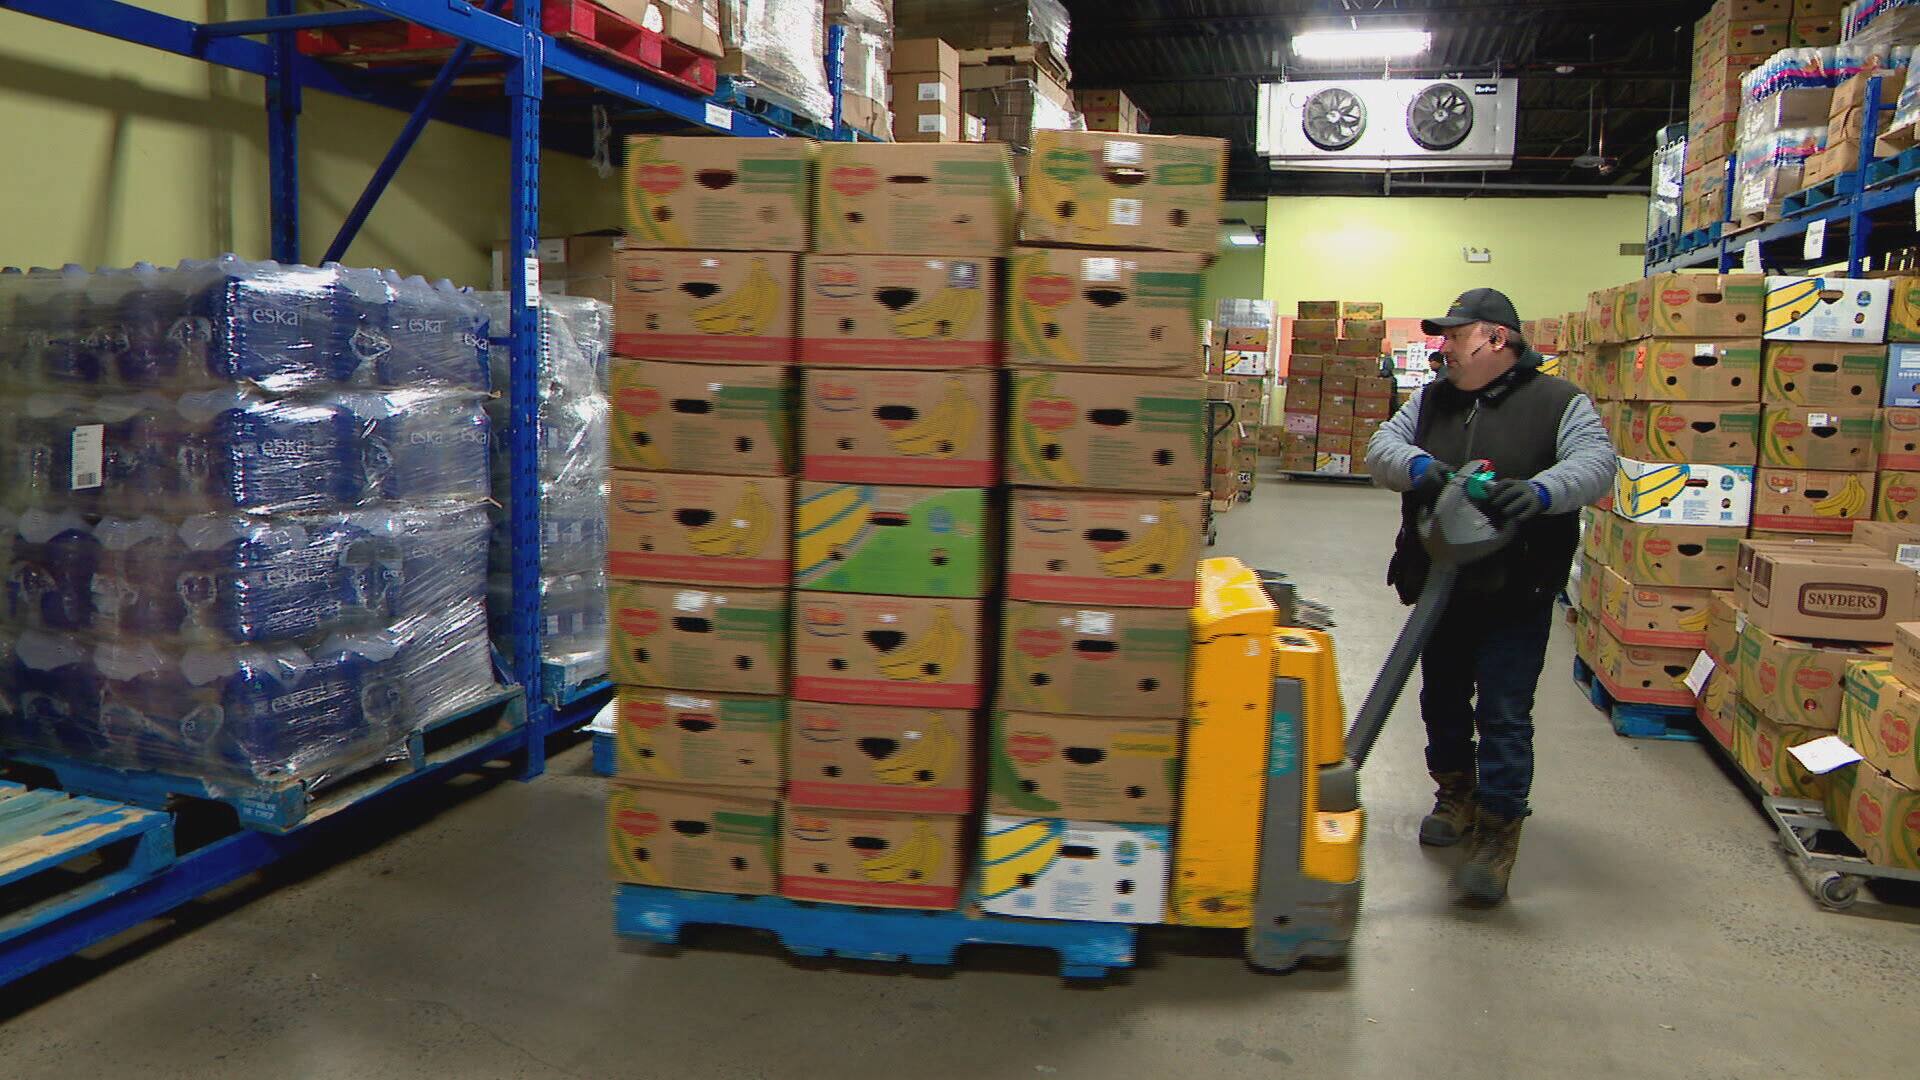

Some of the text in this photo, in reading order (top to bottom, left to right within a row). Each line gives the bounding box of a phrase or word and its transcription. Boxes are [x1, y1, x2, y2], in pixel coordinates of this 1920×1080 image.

[252, 308, 298, 326] eska
[408, 318, 442, 333] eska
[261, 438, 307, 456] eska
[411, 432, 443, 445] eska
[1807, 592, 1878, 609] SNYDER'S
